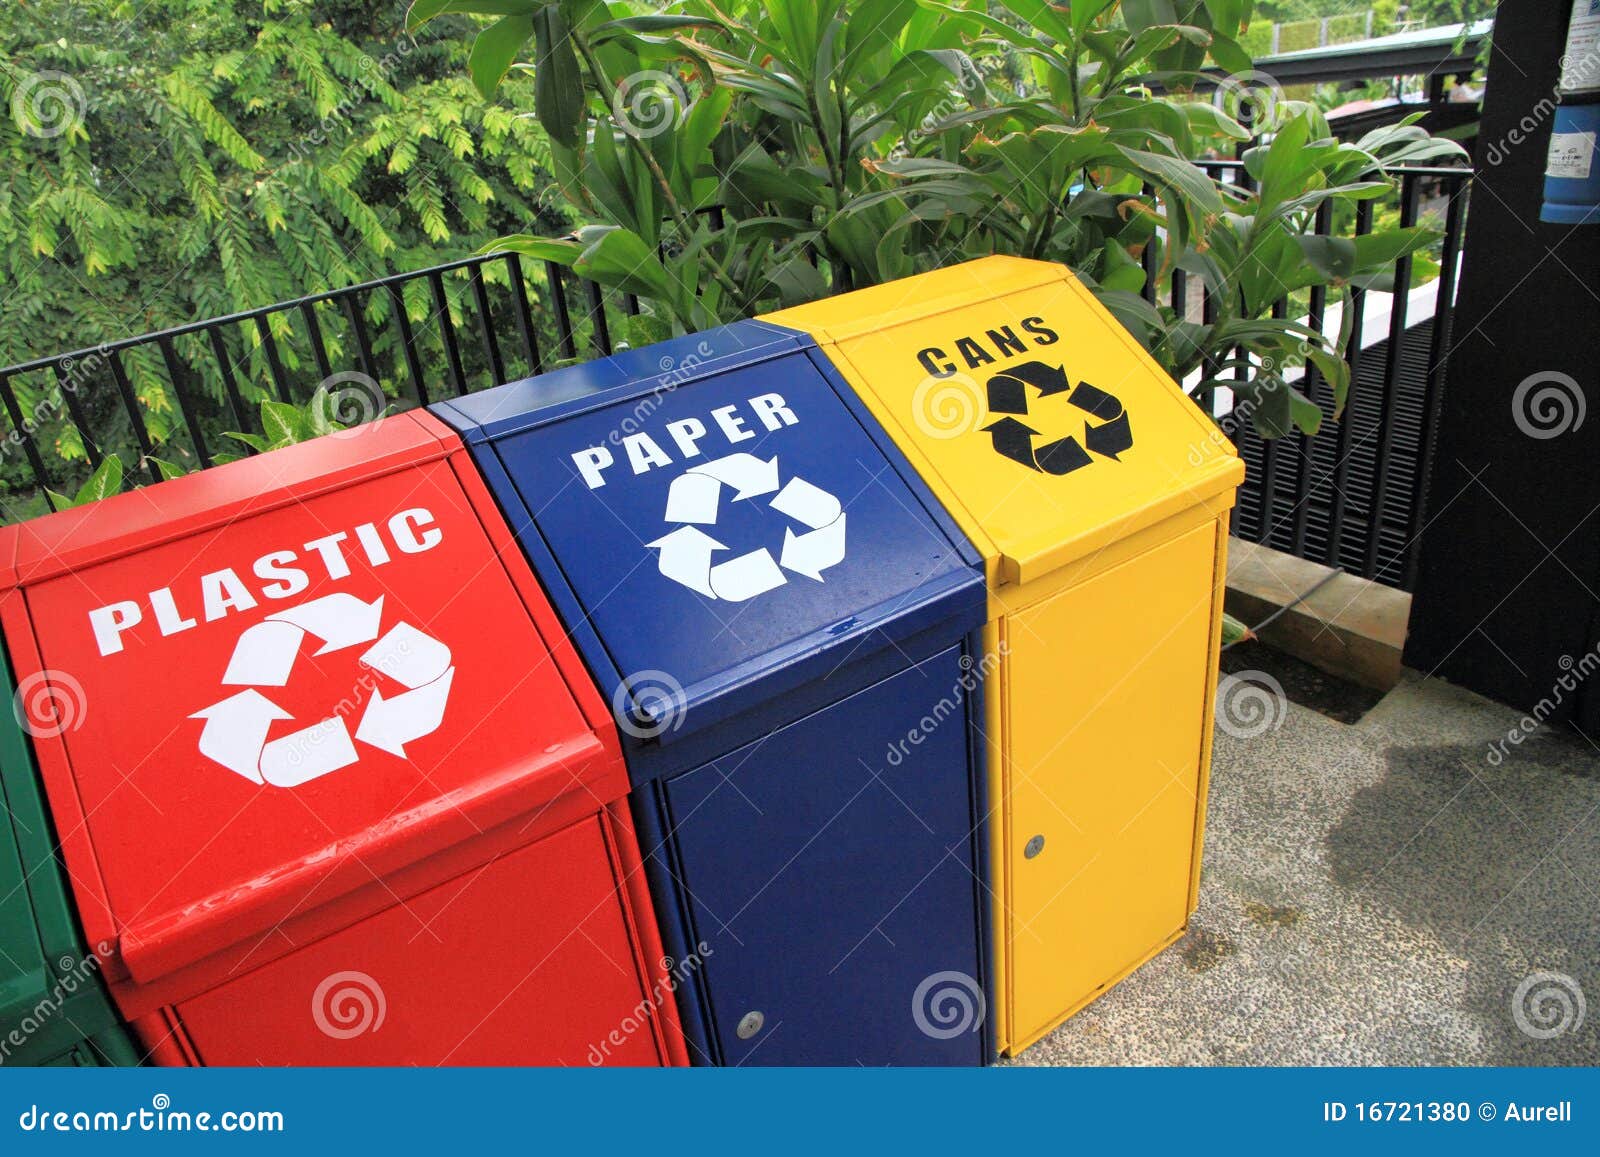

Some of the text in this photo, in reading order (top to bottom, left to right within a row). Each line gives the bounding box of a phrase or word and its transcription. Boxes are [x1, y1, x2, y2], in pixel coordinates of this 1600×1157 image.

[917, 315, 1059, 378] CANS
[571, 392, 799, 490] PAPER
[88, 507, 443, 657] PLASTIC
